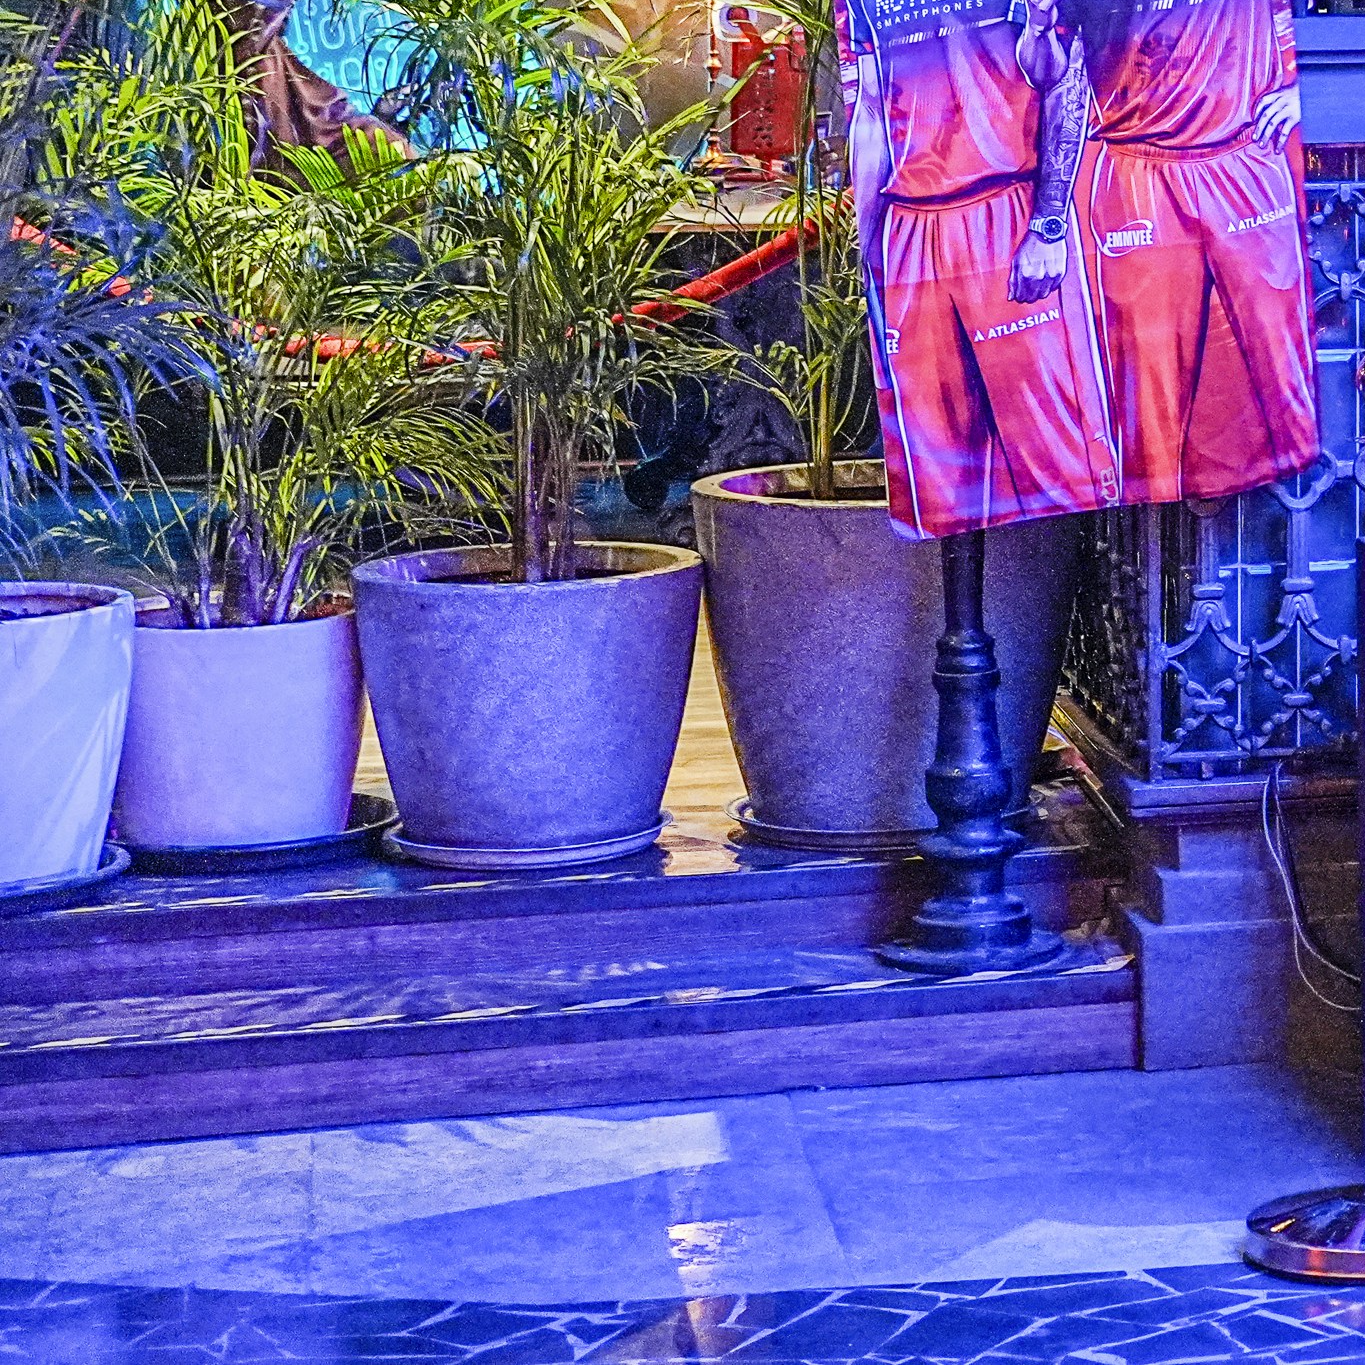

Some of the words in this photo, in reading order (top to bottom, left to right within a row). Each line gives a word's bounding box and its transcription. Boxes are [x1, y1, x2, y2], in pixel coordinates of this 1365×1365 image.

[1238, 205, 1295, 233] ATLASSIAN
[1106, 227, 1154, 247] EMMVEE
[988, 308, 1060, 341] ATLASSIAN
